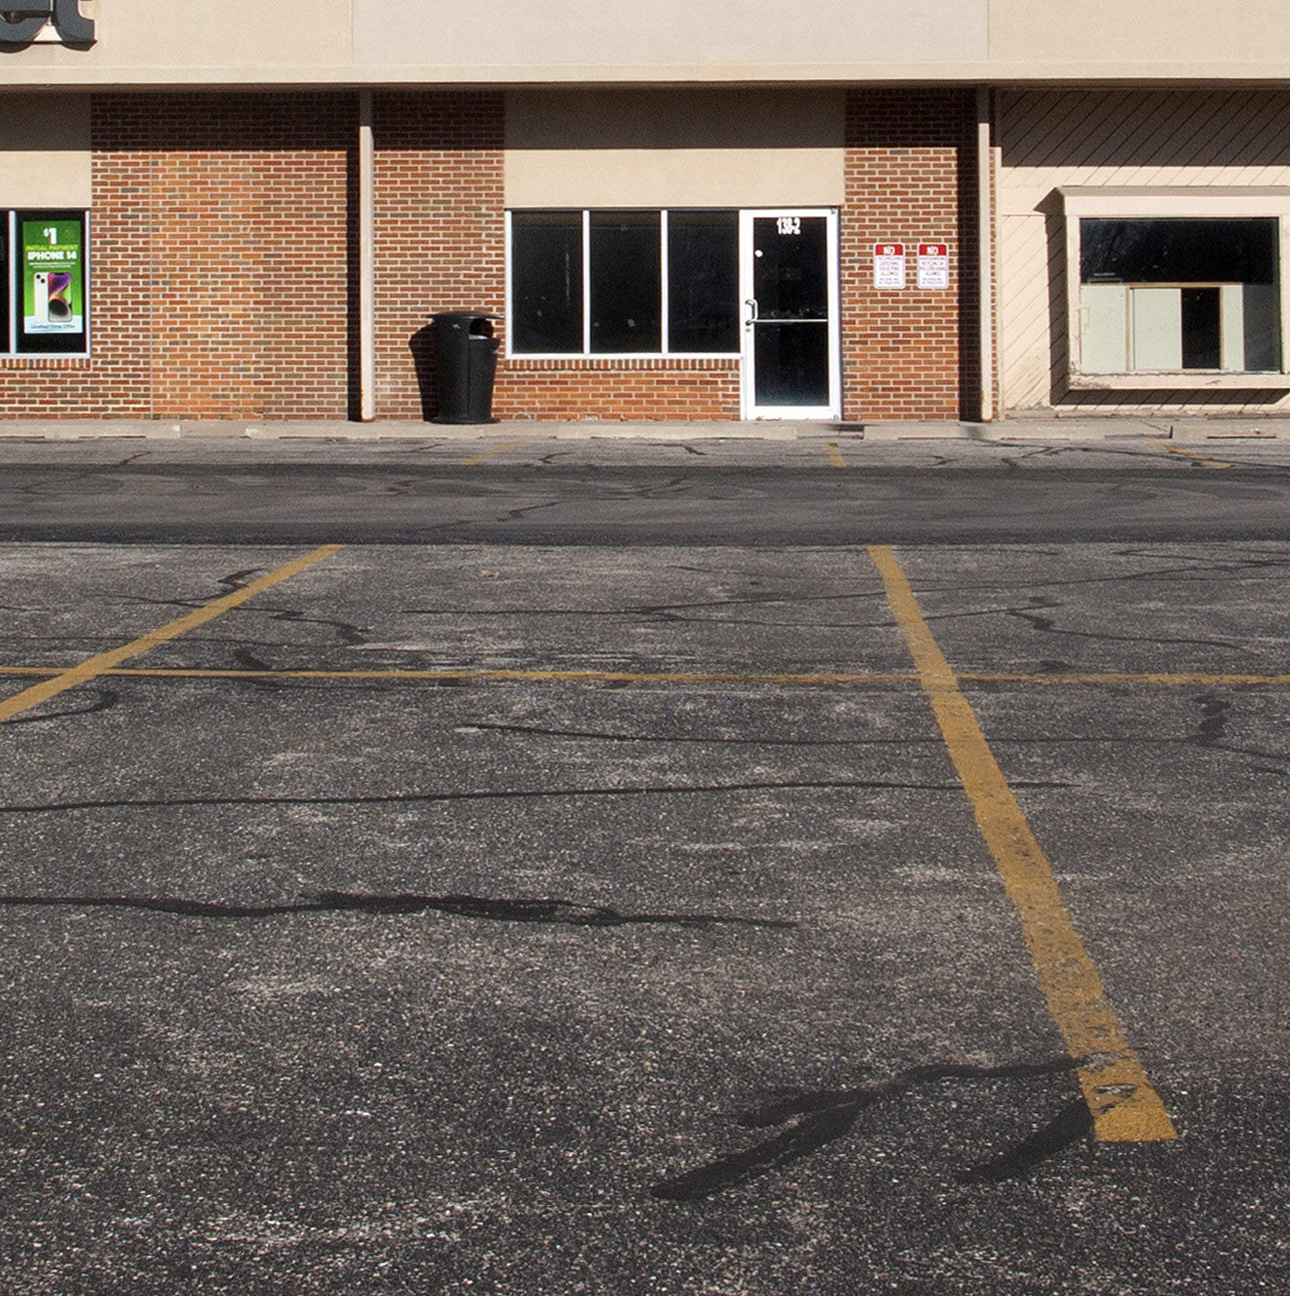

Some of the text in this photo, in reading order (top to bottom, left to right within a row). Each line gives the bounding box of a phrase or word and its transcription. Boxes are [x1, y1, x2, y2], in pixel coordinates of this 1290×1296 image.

[27, 251, 77, 260] IPHONE 14
[883, 246, 895, 256] NO
[927, 246, 939, 256] NO
